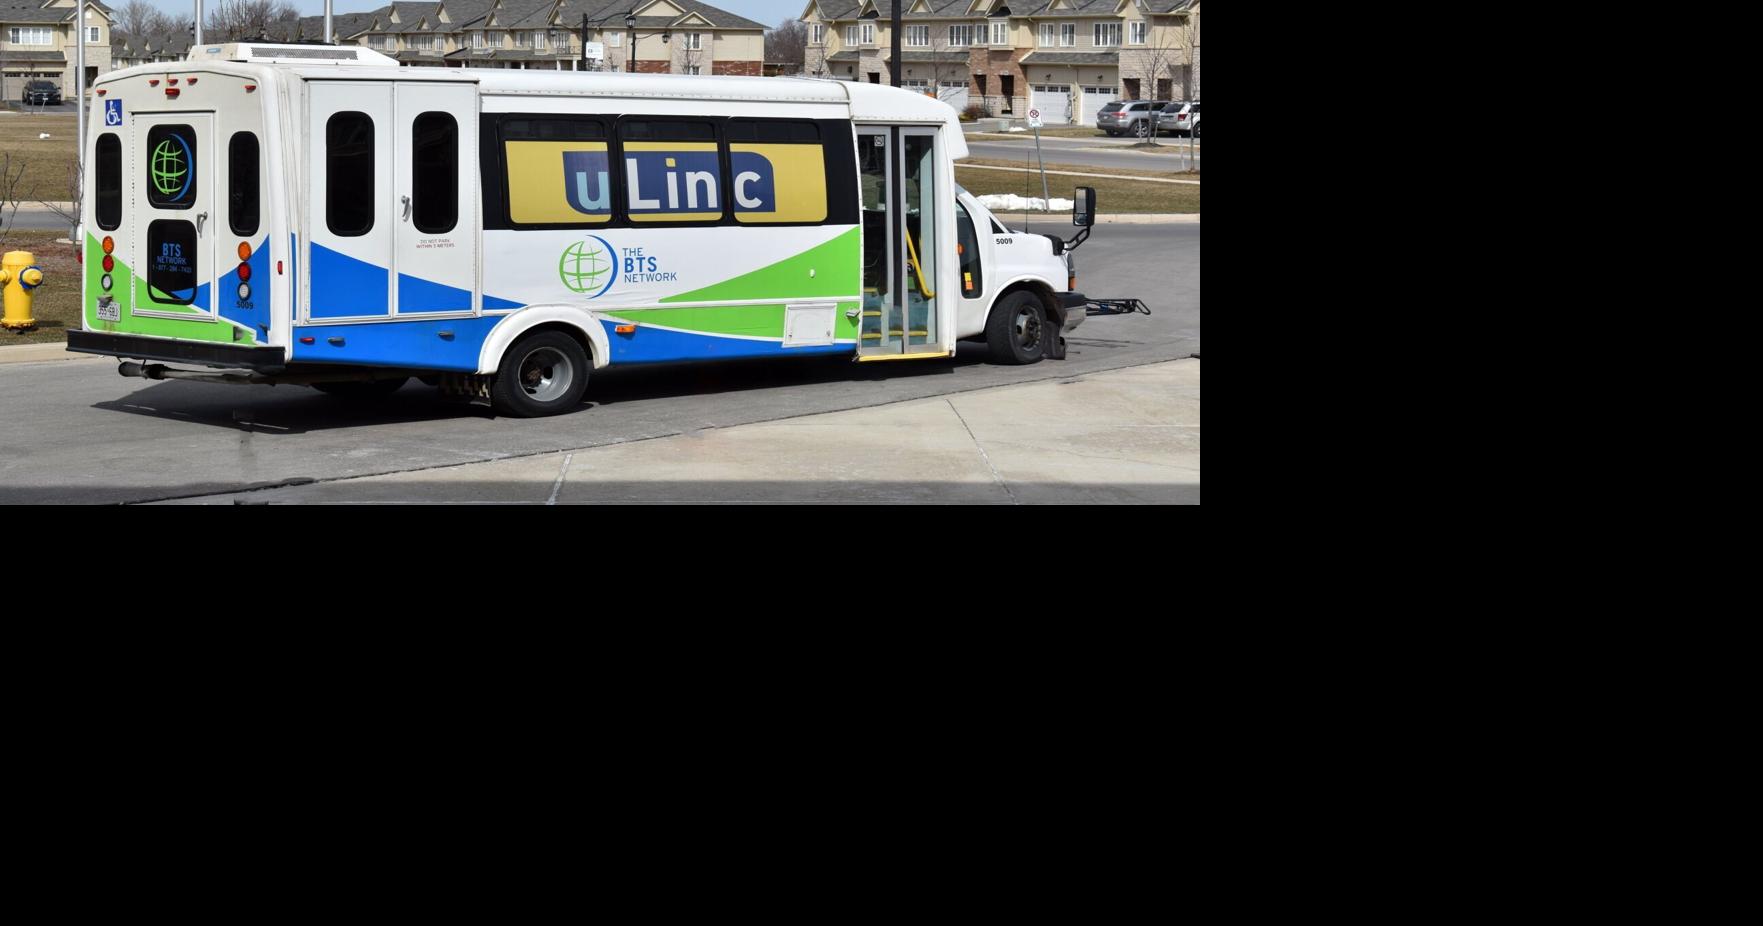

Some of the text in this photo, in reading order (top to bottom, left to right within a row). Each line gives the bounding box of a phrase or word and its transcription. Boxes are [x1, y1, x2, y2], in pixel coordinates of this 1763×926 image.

[162, 243, 181, 257] BTS
[622, 247, 643, 257] THE
[156, 256, 187, 265] NETWORK
[624, 256, 657, 273] BTS
[624, 272, 677, 283] NETWORK
